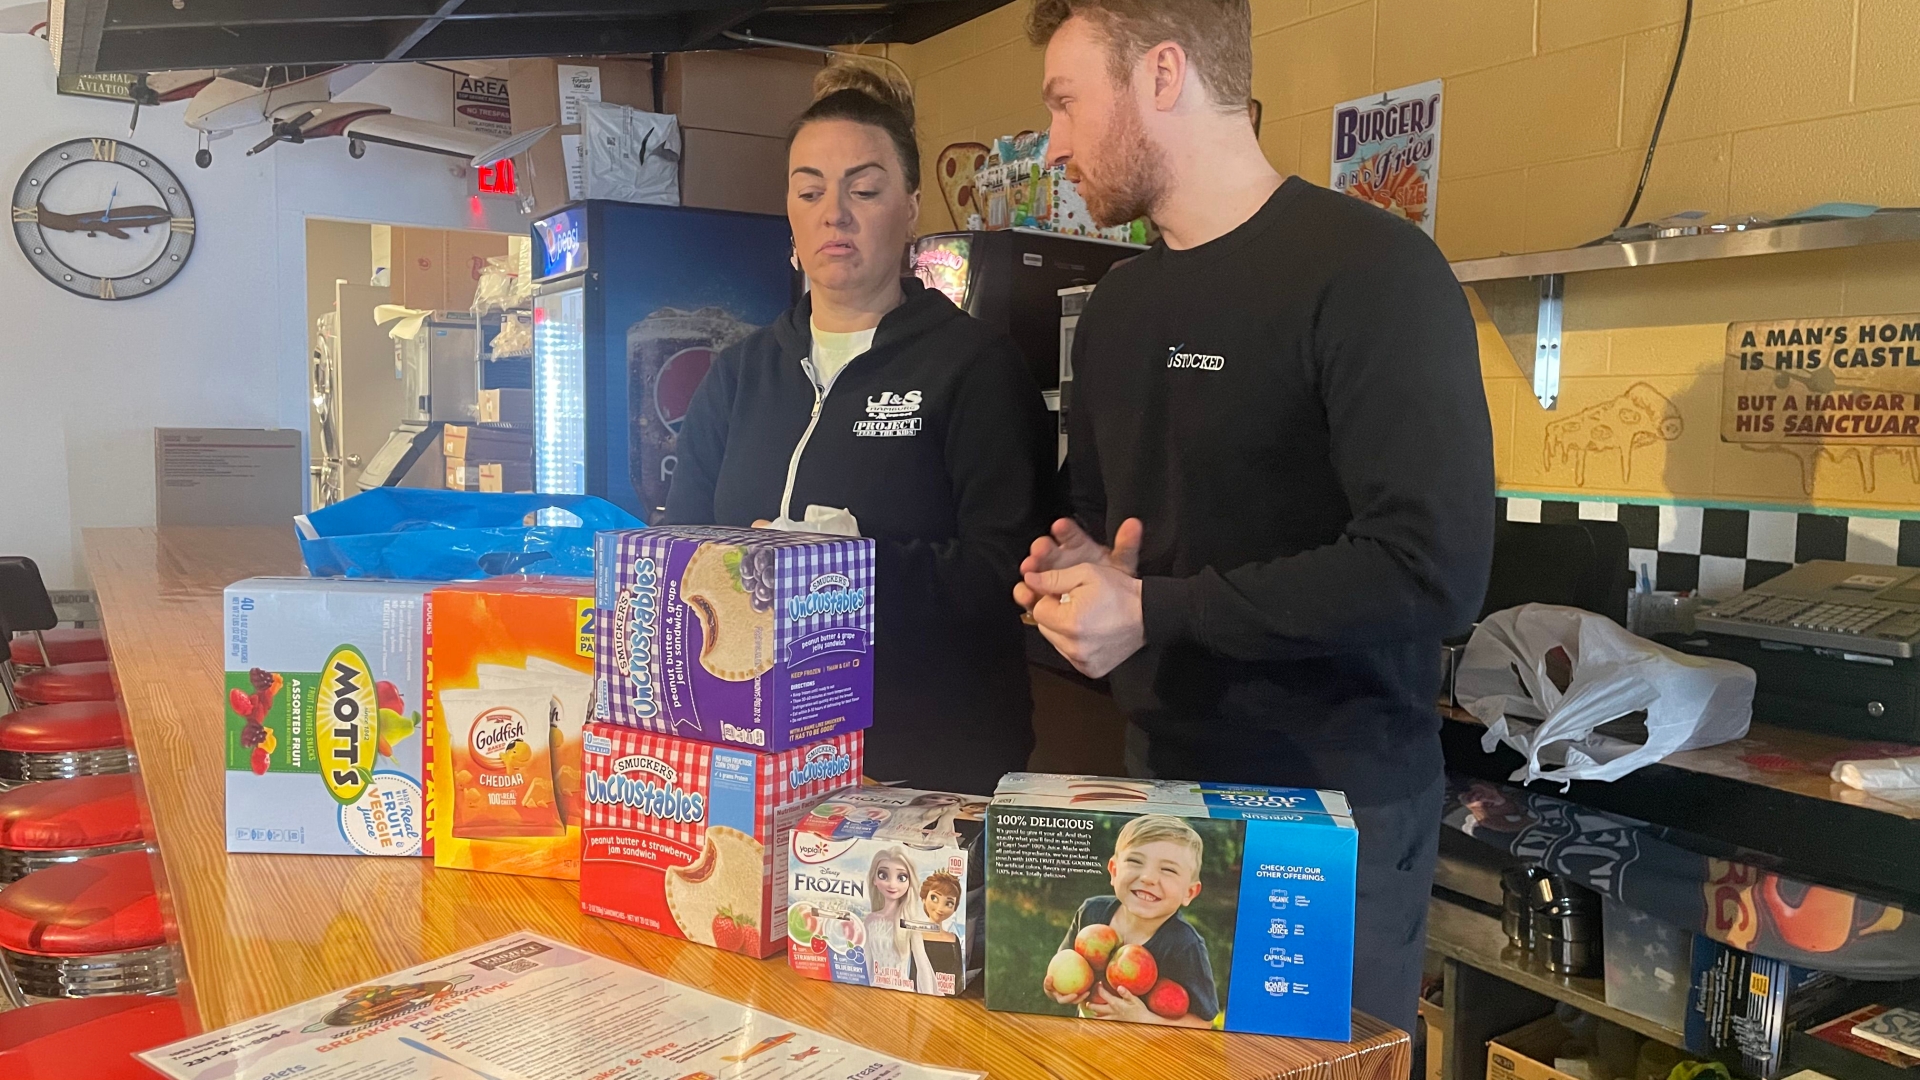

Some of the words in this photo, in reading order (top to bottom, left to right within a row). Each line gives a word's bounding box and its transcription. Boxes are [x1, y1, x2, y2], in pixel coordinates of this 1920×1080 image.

[460, 78, 509, 97] AREA
[467, 107, 478, 115] NO
[1334, 93, 1441, 162] BURGERS
[1335, 169, 1372, 188] AND
[556, 222, 580, 261] pepsi
[1740, 331, 1757, 348] A
[1766, 326, 1848, 347] MAN'S
[1740, 351, 1765, 371] IS
[1775, 349, 1822, 370] HIS
[867, 390, 923, 406] J&S
[1737, 395, 1777, 411] BUT
[1782, 395, 1798, 411] A
[1805, 393, 1905, 411] HANGAR
[857, 419, 919, 431] PROJECT
[1736, 415, 1775, 433] HIS
[811, 574, 848, 590] SMUCKER'S
[241, 597, 255, 612] 40
[665, 579, 678, 613] grape
[666, 616, 674, 626] &
[615, 595, 631, 670] SMUCKER'S
[673, 603, 684, 657] sandwich
[665, 627, 674, 666] butter
[801, 635, 820, 649] peanut
[820, 632, 837, 643] butter
[841, 631, 856, 642] grape
[812, 643, 824, 653] jelly
[824, 639, 846, 649] sandwich
[675, 659, 686, 685] jelly
[790, 671, 804, 679] KEEP
[804, 667, 822, 677] FROZEN
[667, 669, 682, 708] peanut
[790, 680, 816, 691] DIRECTIONS
[306, 686, 316, 703] FRUIT
[291, 678, 301, 735] ASSORTED
[597, 703, 604, 718] 10
[305, 705, 314, 736] FLAVORED
[476, 720, 525, 750] Goldfish
[583, 732, 593, 744] 10
[789, 734, 795, 742] IT
[794, 732, 806, 741] HAS
[812, 727, 820, 735] BE
[291, 737, 301, 768] FRUIT
[306, 737, 316, 761] SNACKS
[806, 744, 837, 761] SMUCKER'S
[714, 754, 723, 762] NO
[618, 756, 675, 781] SMUCKER'S
[479, 773, 524, 788] CHEDDAR
[735, 775, 749, 783] Protein
[395, 790, 404, 806] WITH
[402, 788, 411, 804] MADE
[1220, 793, 1307, 804] JUICE
[1229, 800, 1296, 808] 100%
[381, 790, 404, 838] FRUIT
[776, 805, 800, 817] Nutrition
[801, 800, 815, 809] Facts
[367, 787, 393, 848] VEGGIE
[399, 805, 420, 839] Real
[996, 814, 1027, 826] 100%
[1030, 816, 1094, 831] DELICIOUS
[590, 836, 614, 847] peanut
[615, 836, 640, 848] butter
[641, 838, 647, 848] &
[648, 842, 693, 863] strawberry
[607, 845, 620, 855] jam
[622, 846, 657, 861] sandwich
[950, 858, 962, 867] 100
[1260, 863, 1286, 872] CHECK
[1286, 865, 1303, 873] OUT
[1304, 866, 1321, 874] OUR
[819, 865, 841, 878] Disney
[1256, 870, 1281, 879] OTHER
[794, 872, 865, 899] FROZEN
[1268, 895, 1289, 904] ORGANIC
[1267, 927, 1289, 935] JUICE
[792, 943, 798, 951] 4
[793, 953, 827, 963] STRAWBERRY
[833, 953, 838, 961] 4
[834, 963, 863, 974] BLUEBERRY
[936, 972, 955, 982] LOWFAT
[937, 981, 955, 989] YOGURT
[314, 1010, 428, 1054] BREAKFAST
[433, 979, 515, 1012] ANYTIME
[409, 1006, 468, 1031] Platters
[624, 1057, 643, 1068] &
[639, 1041, 679, 1060] More
[846, 1061, 884, 1080] Treats
